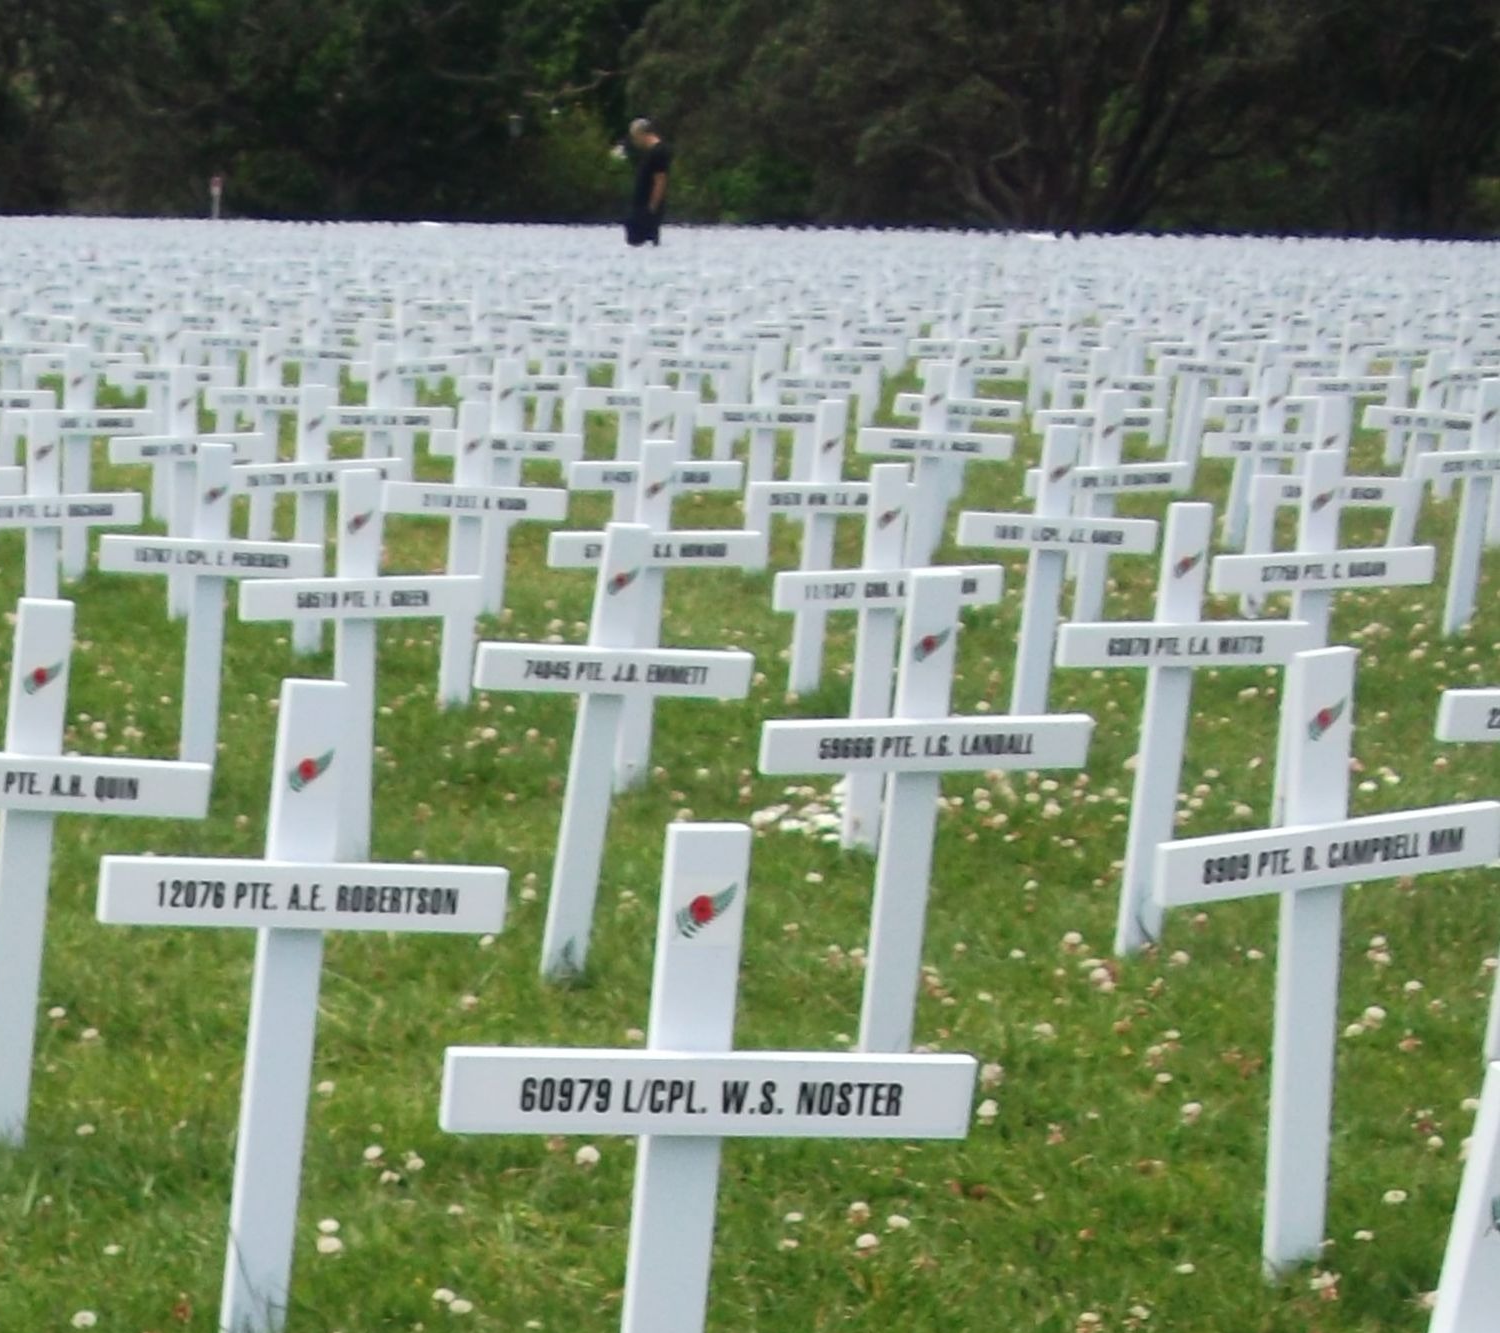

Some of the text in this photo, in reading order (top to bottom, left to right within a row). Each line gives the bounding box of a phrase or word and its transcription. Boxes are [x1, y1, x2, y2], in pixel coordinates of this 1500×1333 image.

[1155, 637, 1180, 656] PTE.
[576, 662, 604, 681] PTE.
[881, 736, 916, 757] PTE.
[4, 771, 41, 795] PTE.
[1257, 849, 1294, 877] PTE.
[1328, 833, 1419, 868] CAMPBELL
[1428, 827, 1464, 855] MM
[159, 880, 458, 915] 12076 PTE. A.E. ROBERTSON
[521, 1077, 903, 1116] 60979 L/CPL. W.S. NOSTER
